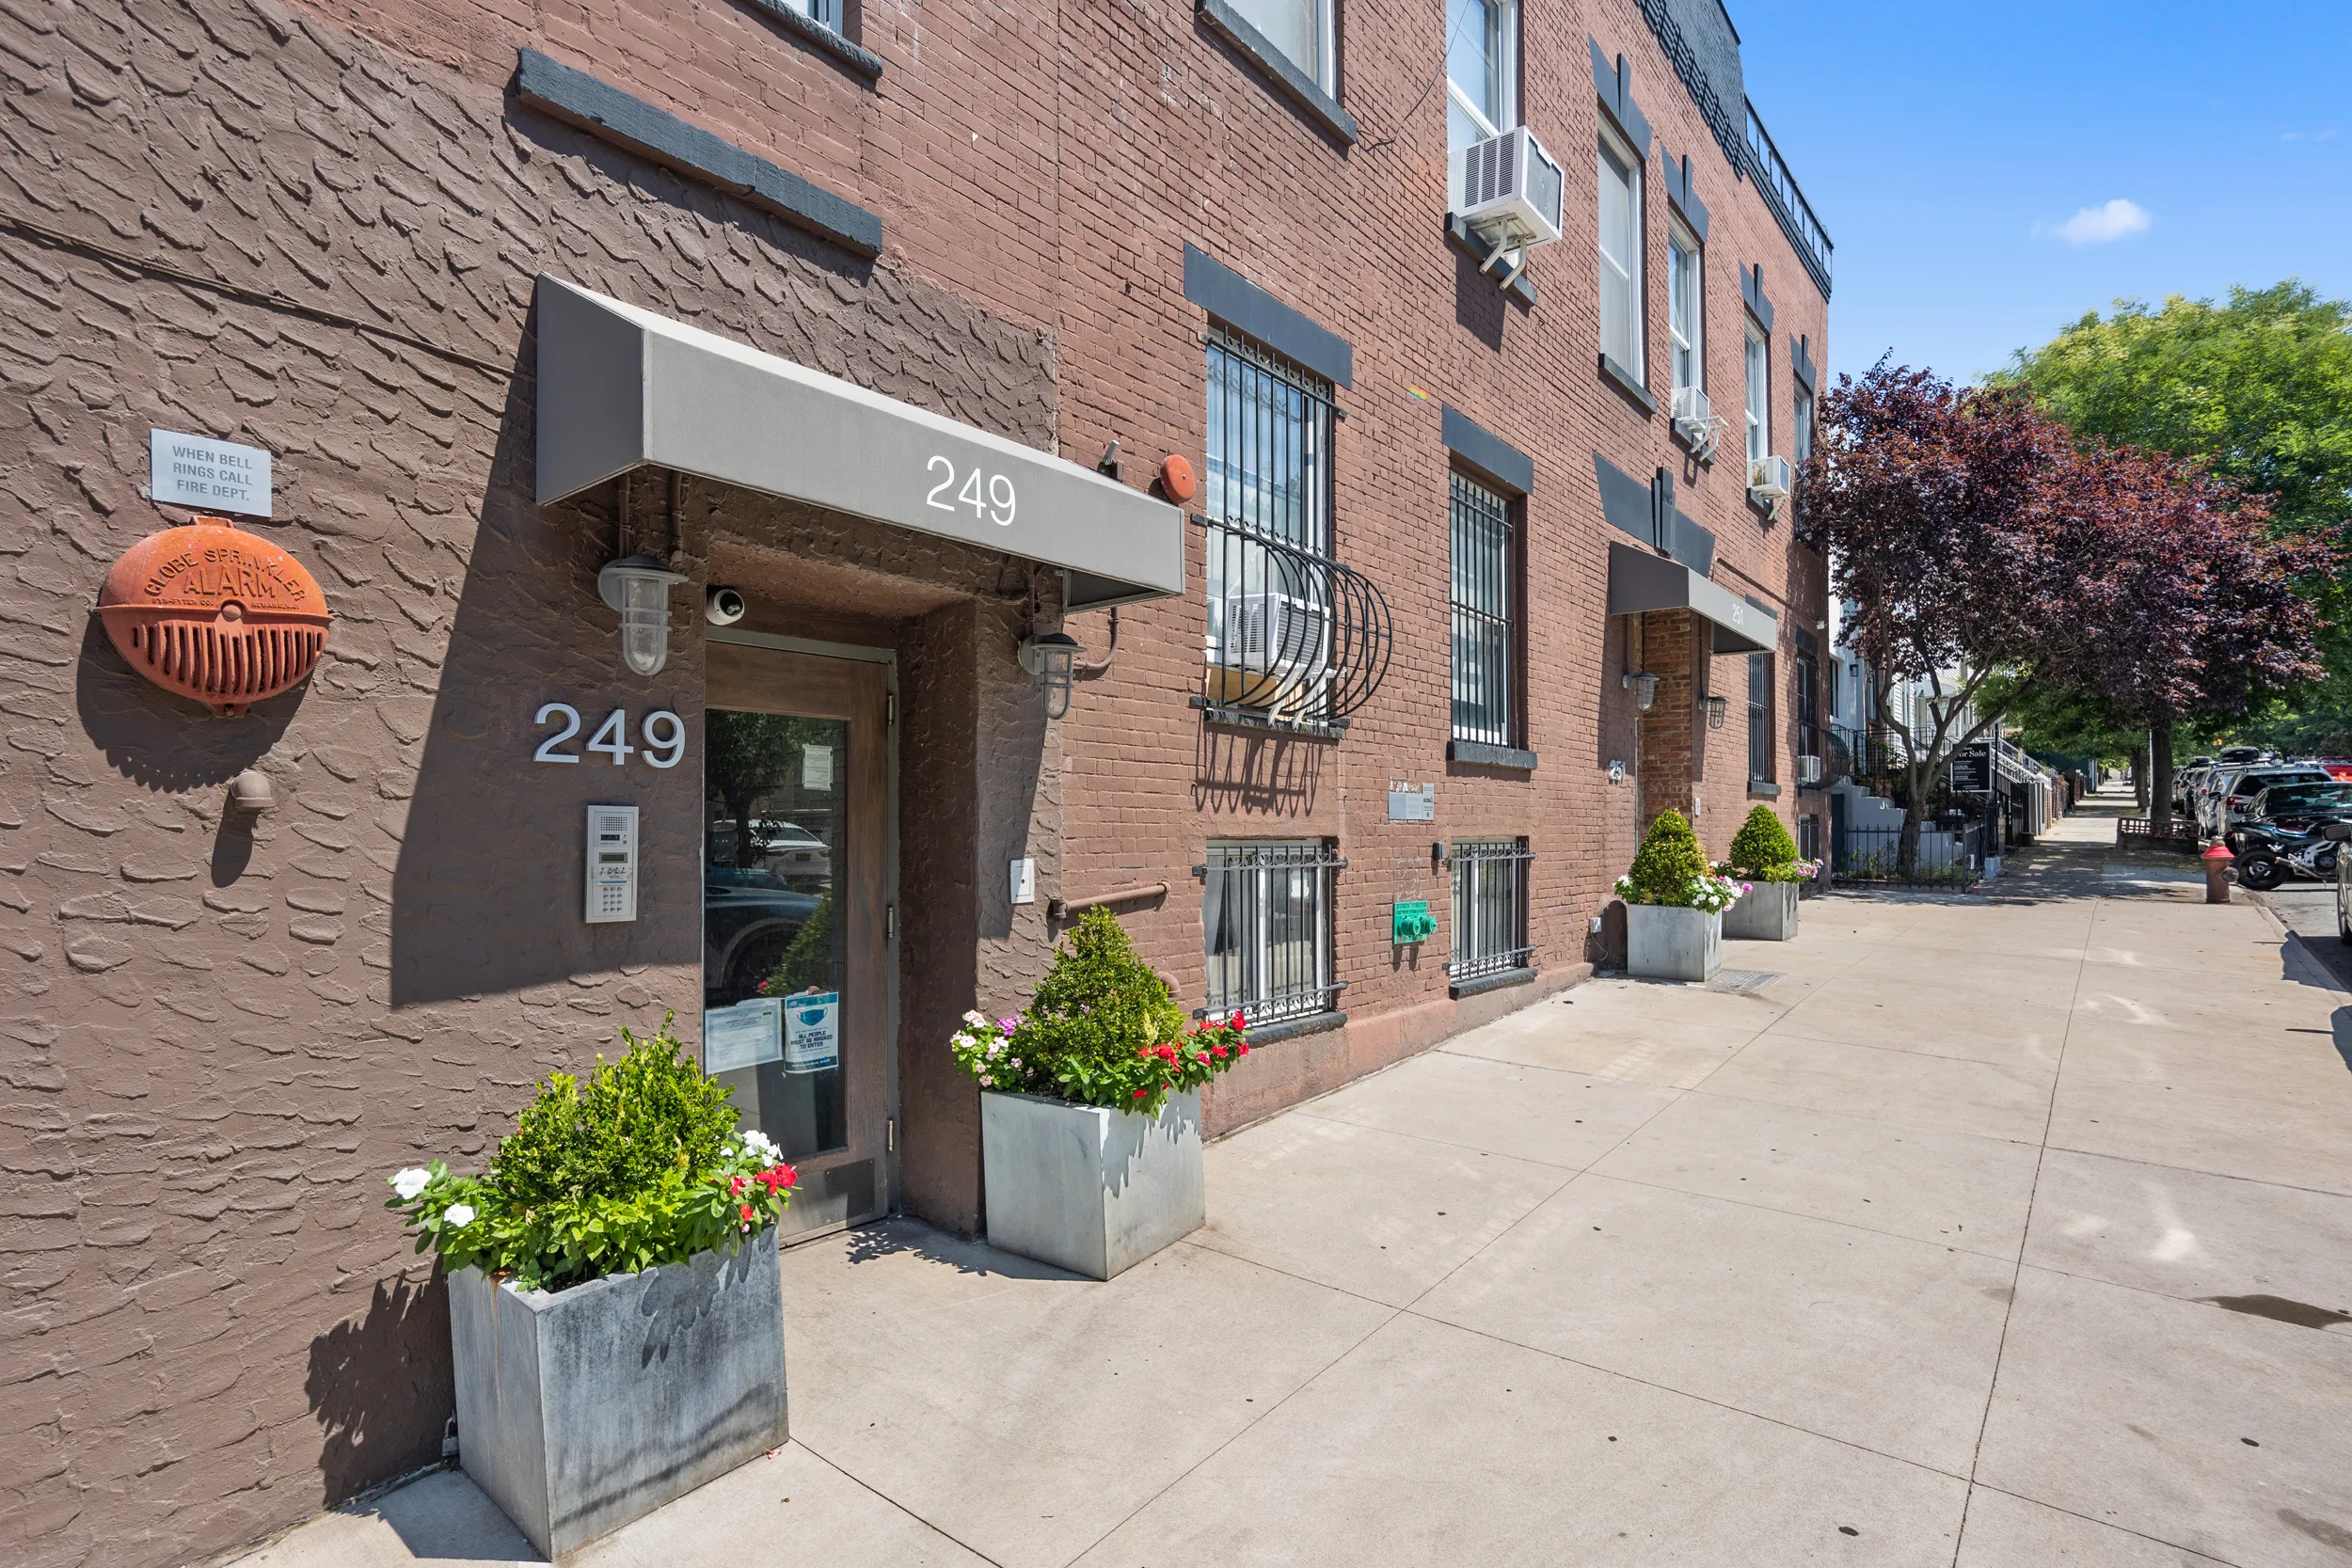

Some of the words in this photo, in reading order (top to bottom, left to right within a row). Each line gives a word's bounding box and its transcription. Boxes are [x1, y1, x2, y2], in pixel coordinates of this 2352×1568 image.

[172, 445, 215, 464] WHEN
[219, 453, 252, 470] BELL
[173, 462, 215, 480] RINGS
[219, 469, 252, 485] CALL
[177, 479, 208, 495] FIRE
[213, 484, 249, 500] DEPT.
[926, 455, 1016, 527] 249
[143, 552, 199, 597] GLOBE
[203, 547, 307, 602] SPRINKLER
[183, 564, 276, 598] ALARM
[1732, 603, 1743, 626] 251
[533, 703, 686, 768] 249
[814, 1034, 834, 1042] MASKED
